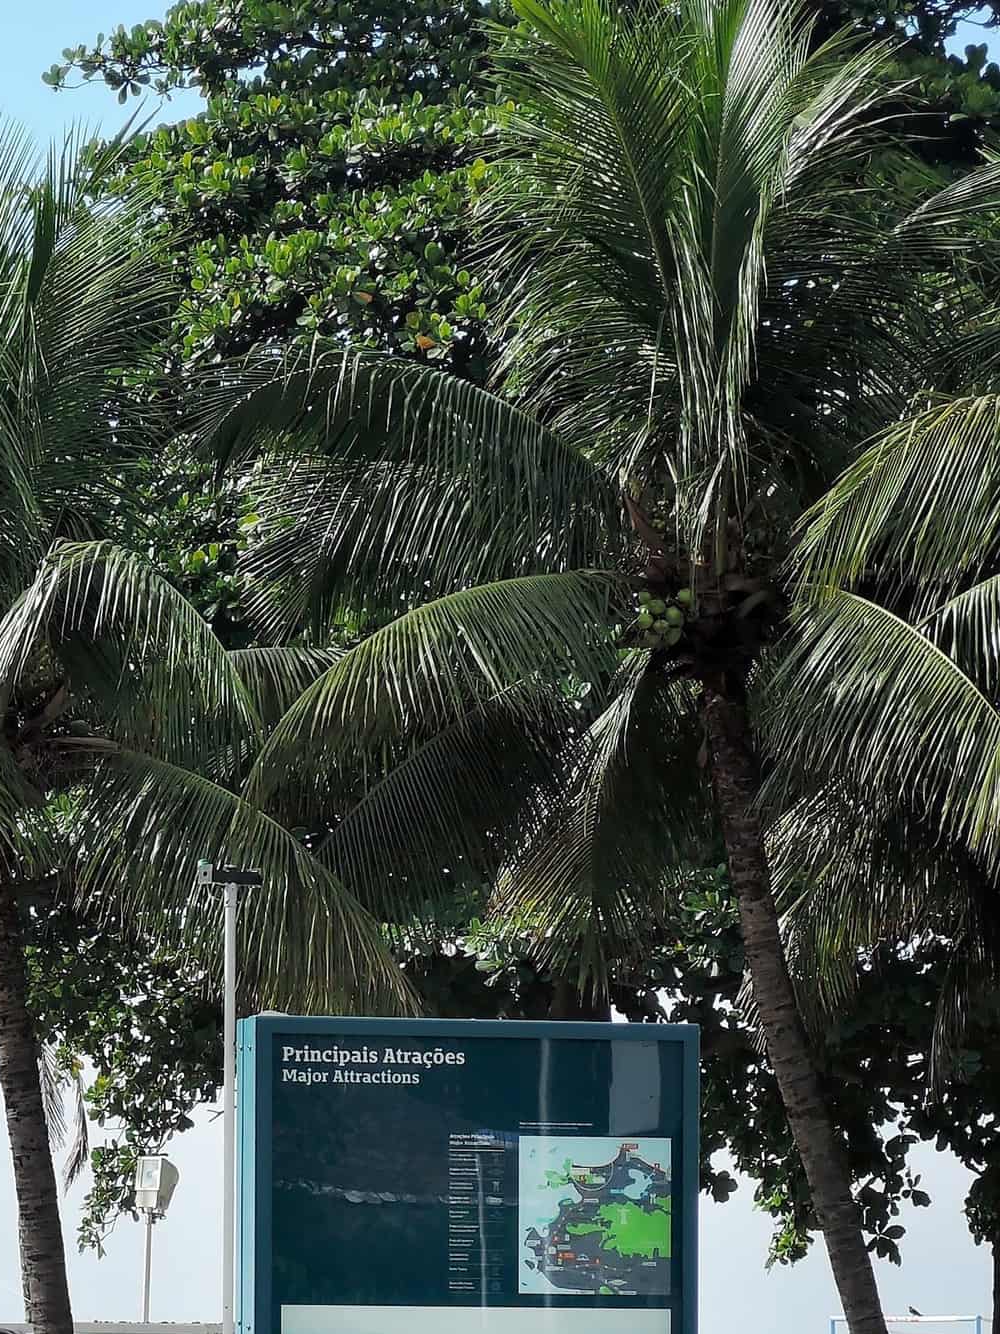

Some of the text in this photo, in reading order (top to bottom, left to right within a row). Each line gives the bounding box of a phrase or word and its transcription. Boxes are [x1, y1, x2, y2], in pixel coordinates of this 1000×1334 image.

[282, 1045, 465, 1069] Principais Atrações
[281, 1068, 420, 1086] Major Attractions
